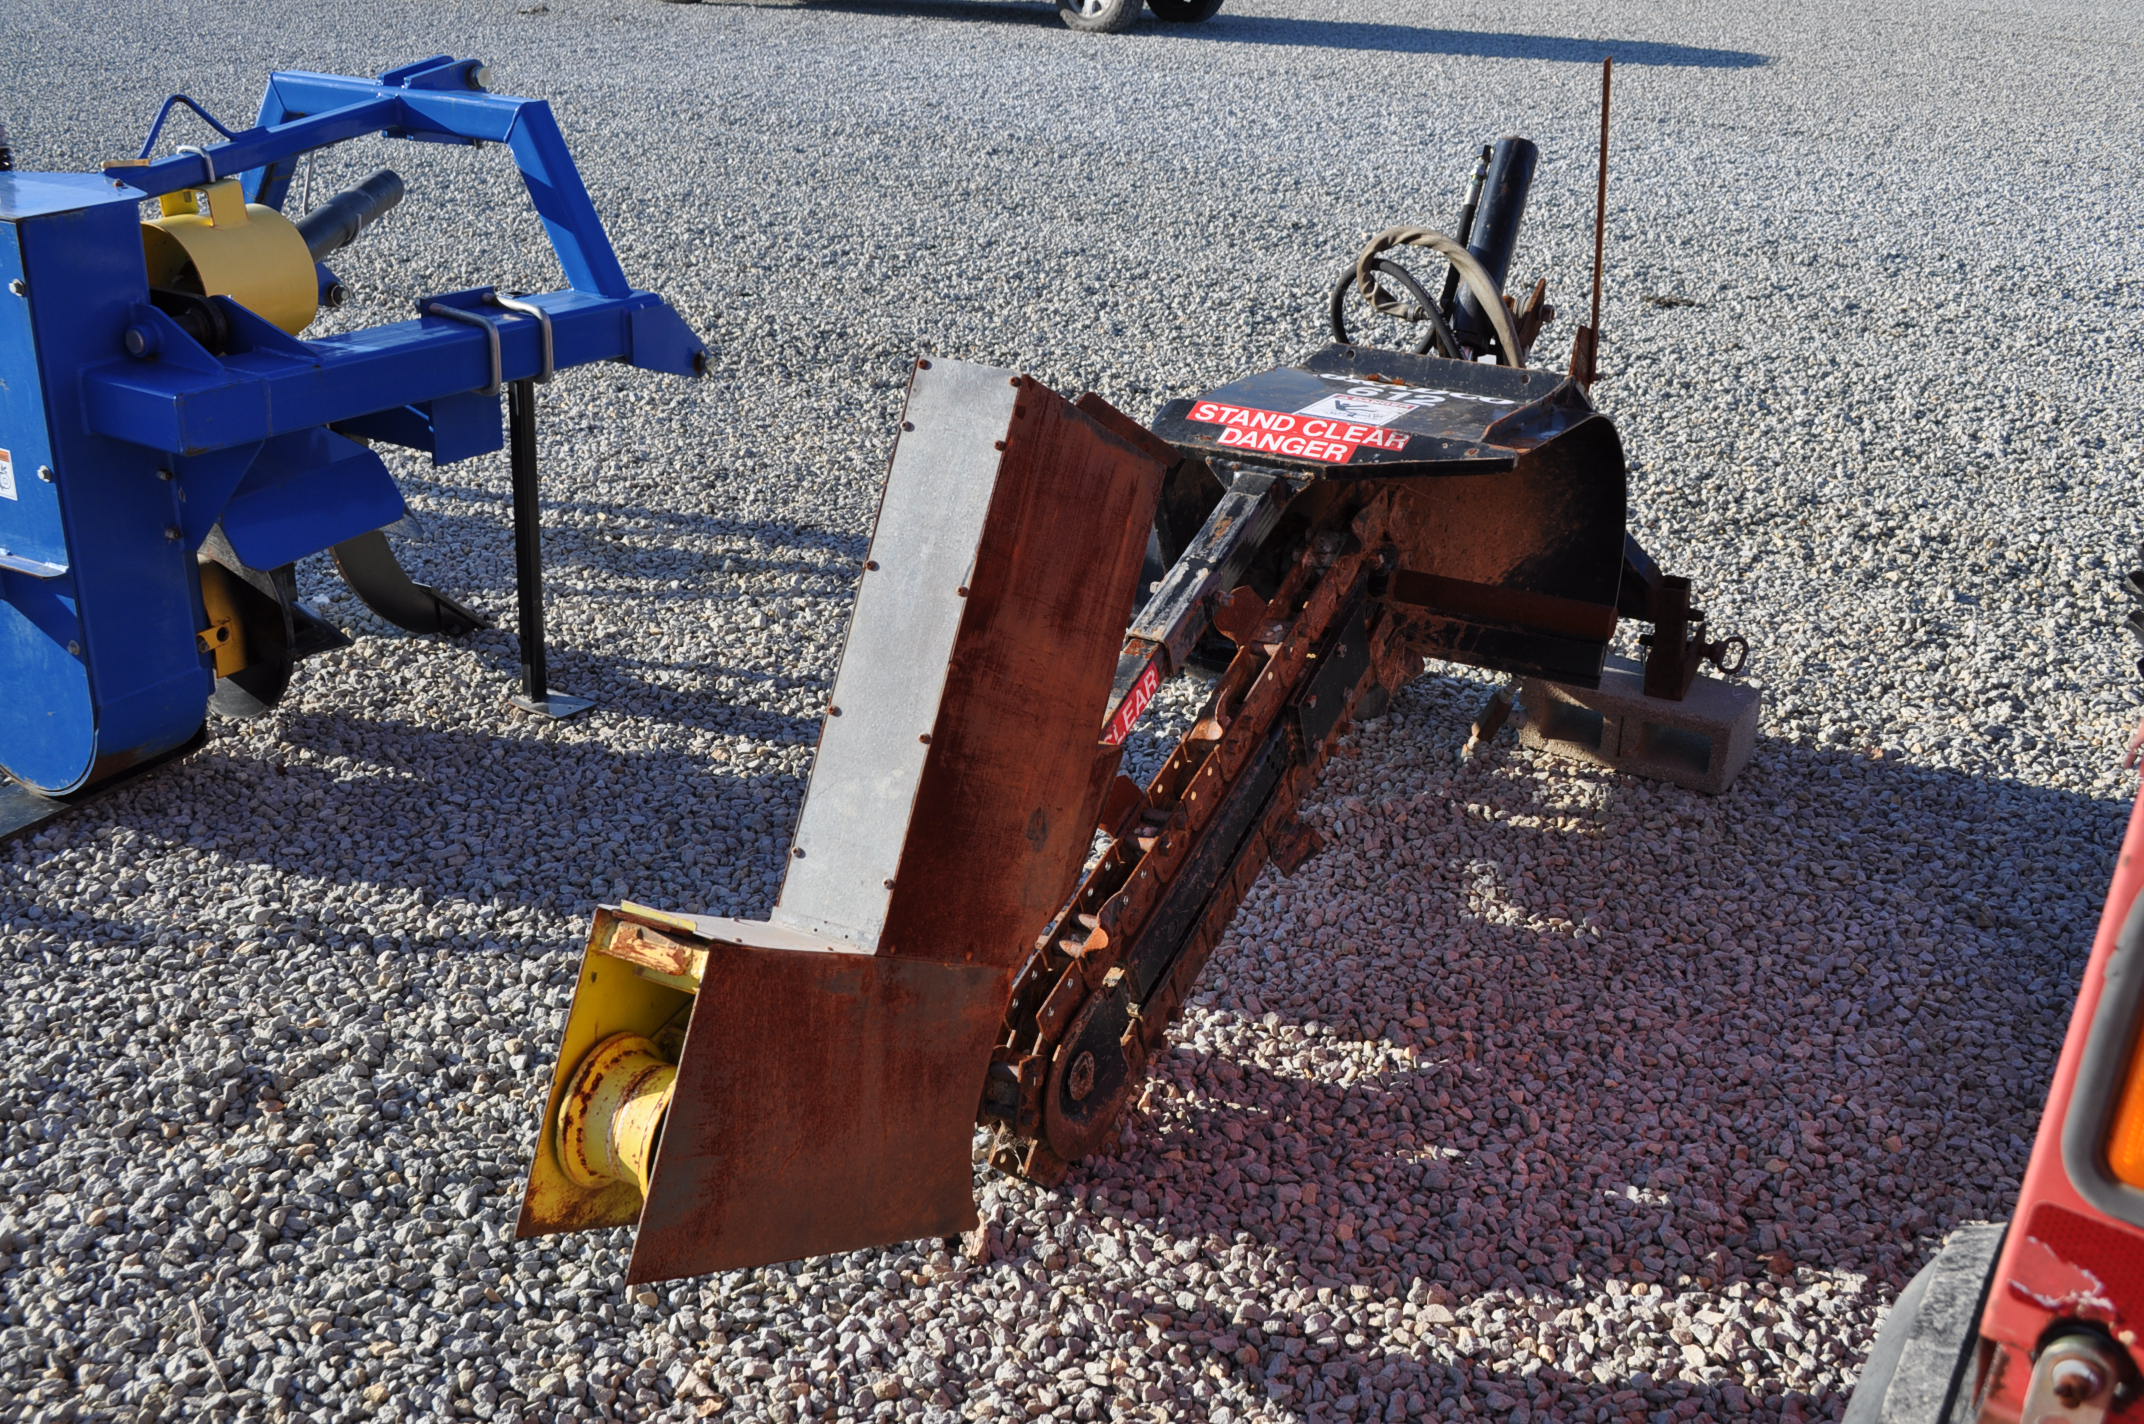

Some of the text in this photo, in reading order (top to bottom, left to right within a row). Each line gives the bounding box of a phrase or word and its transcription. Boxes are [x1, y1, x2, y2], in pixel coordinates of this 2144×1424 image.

[1346, 387, 1446, 407] 612
[1195, 404, 1412, 449] STAND CLEAR
[1217, 428, 1349, 461] DANGER
